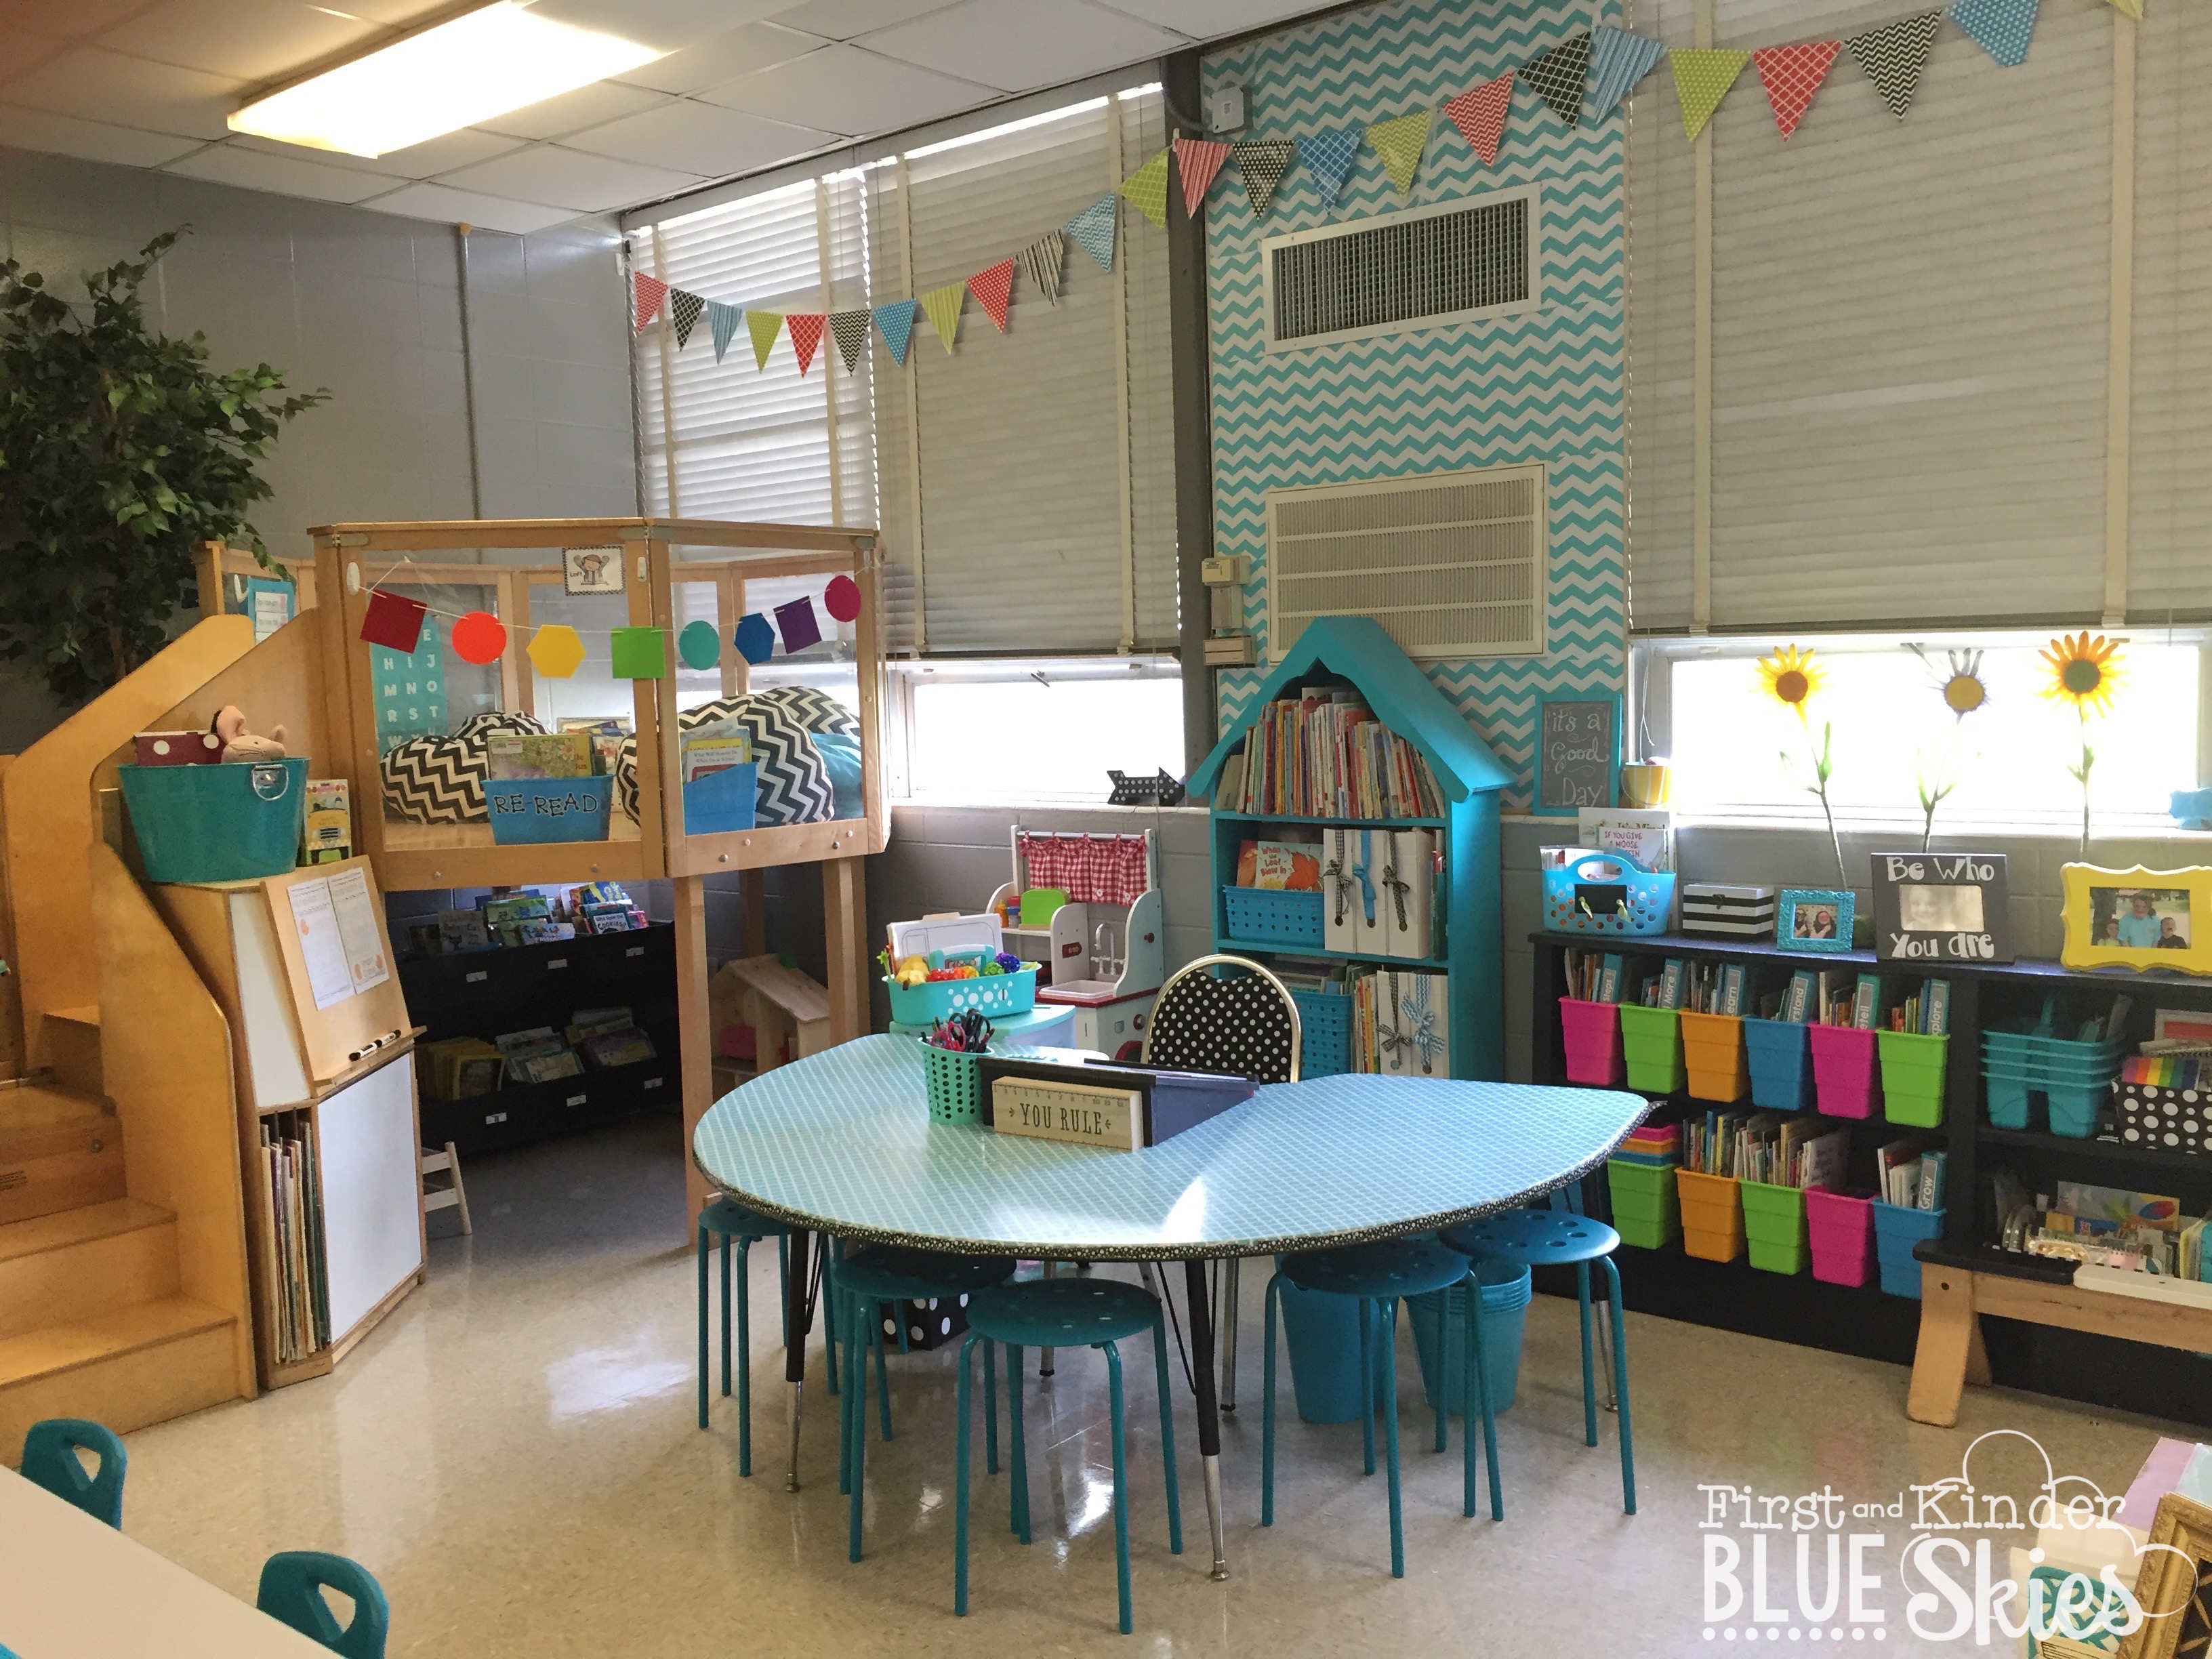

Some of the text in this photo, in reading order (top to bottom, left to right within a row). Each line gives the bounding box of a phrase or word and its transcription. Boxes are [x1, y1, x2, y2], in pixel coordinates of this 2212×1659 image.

[422, 629, 431, 641] E
[383, 654, 435, 670] H I J
[384, 680, 437, 697] M N O
[387, 705, 438, 722] R S T
[1587, 713, 1601, 731] a
[1551, 736, 1610, 774] Good
[1562, 777, 1603, 807] Day
[1604, 830, 1643, 840] IF YOU GIVE
[1616, 840, 1638, 848] MOOSE
[1886, 857, 1994, 882] Be Who
[1890, 933, 1994, 958] You are
[1664, 976, 1675, 1004] More
[1727, 986, 1737, 1017] earn
[1792, 987, 1804, 1023] rstand
[1858, 1005, 1869, 1030] etell
[1931, 1000, 1942, 1036] xplore
[1020, 1103, 1102, 1135] YOU RULE
[1919, 1176, 1933, 1209] Grow
